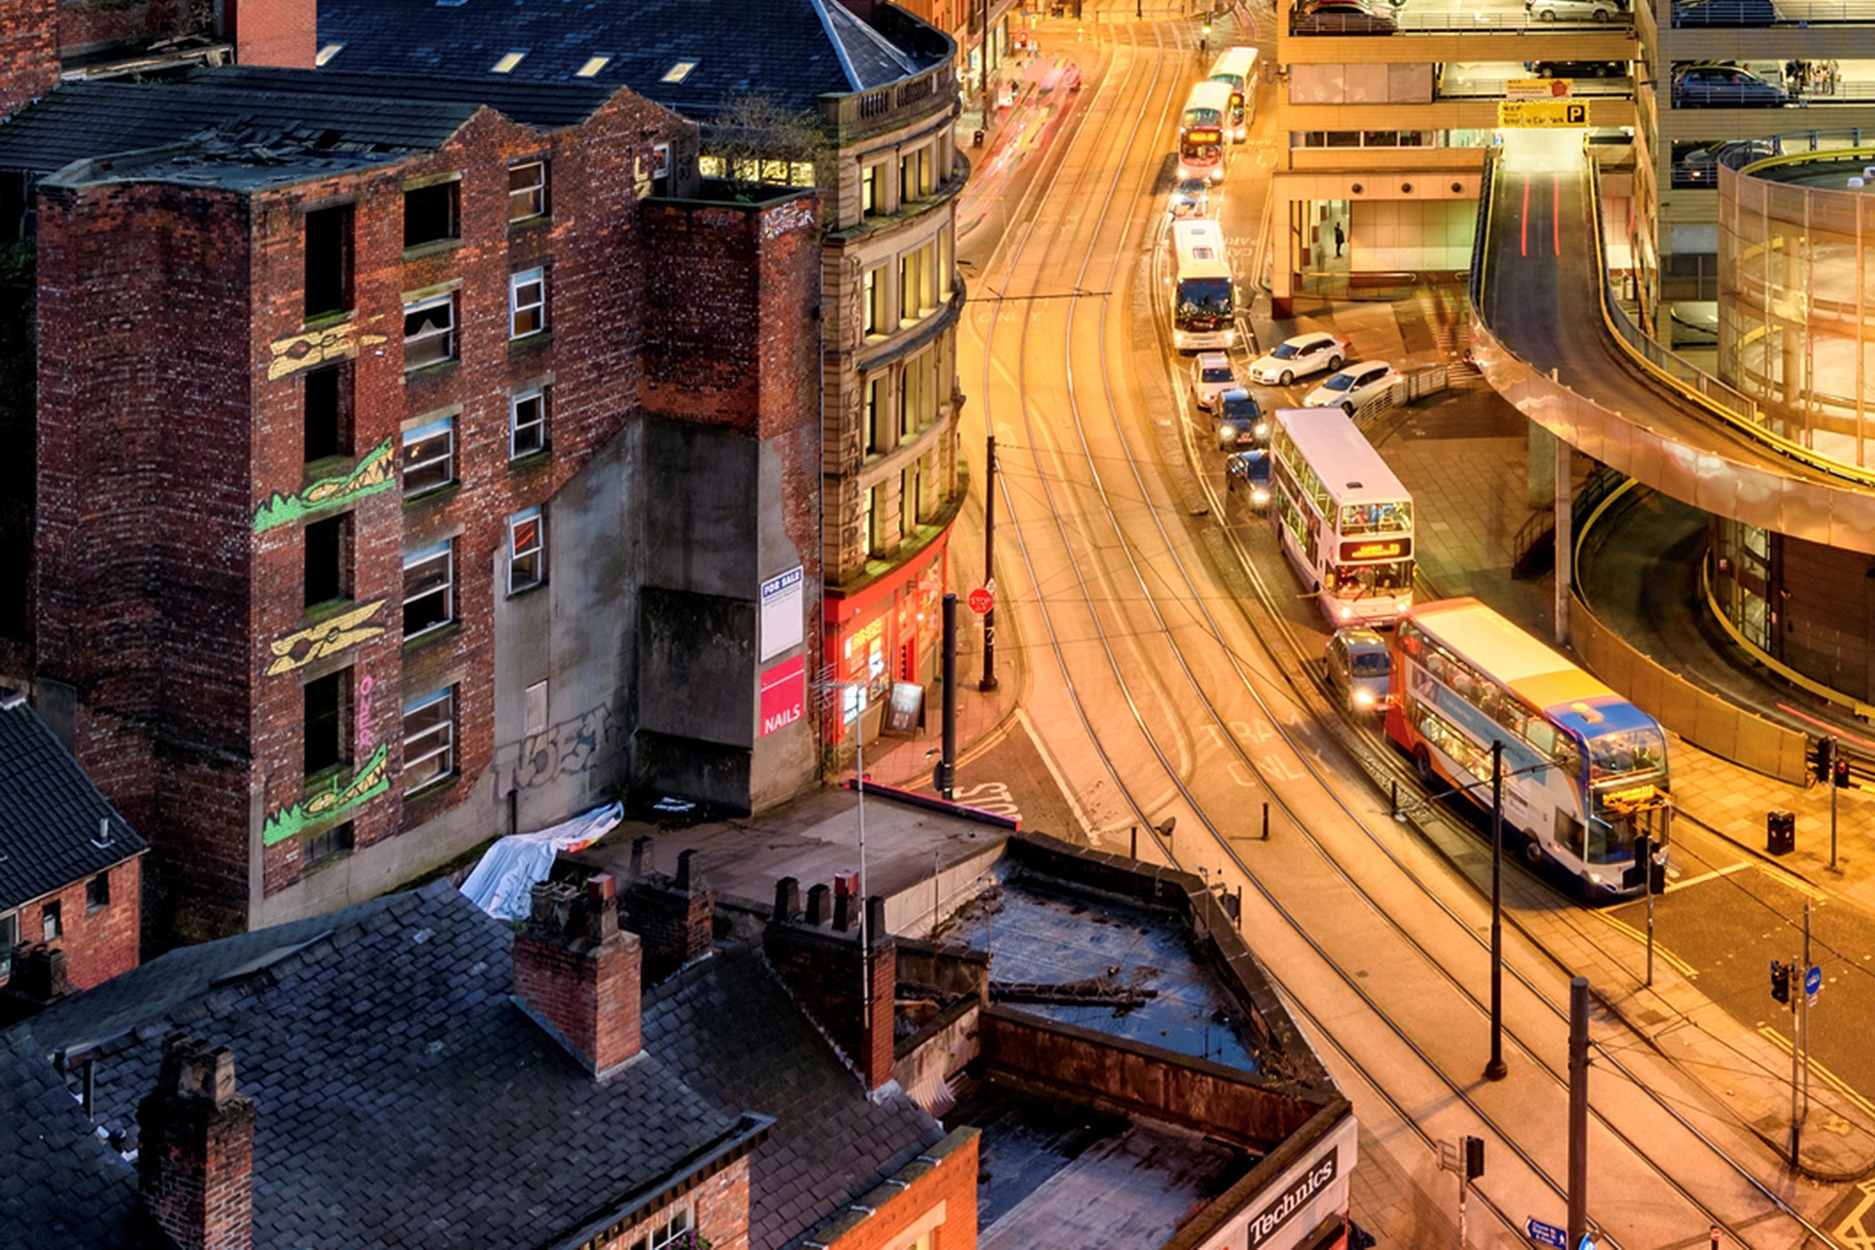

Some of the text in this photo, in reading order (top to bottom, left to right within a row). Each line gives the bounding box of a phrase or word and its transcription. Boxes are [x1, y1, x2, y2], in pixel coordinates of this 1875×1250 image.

[763, 571, 800, 595] FOR SALE
[764, 703, 801, 734] NAILS
[1200, 713, 1313, 748] TRAM
[1226, 748, 1332, 787] ONLY
[952, 781, 1023, 821] STO
[1250, 1160, 1333, 1245] Technics
